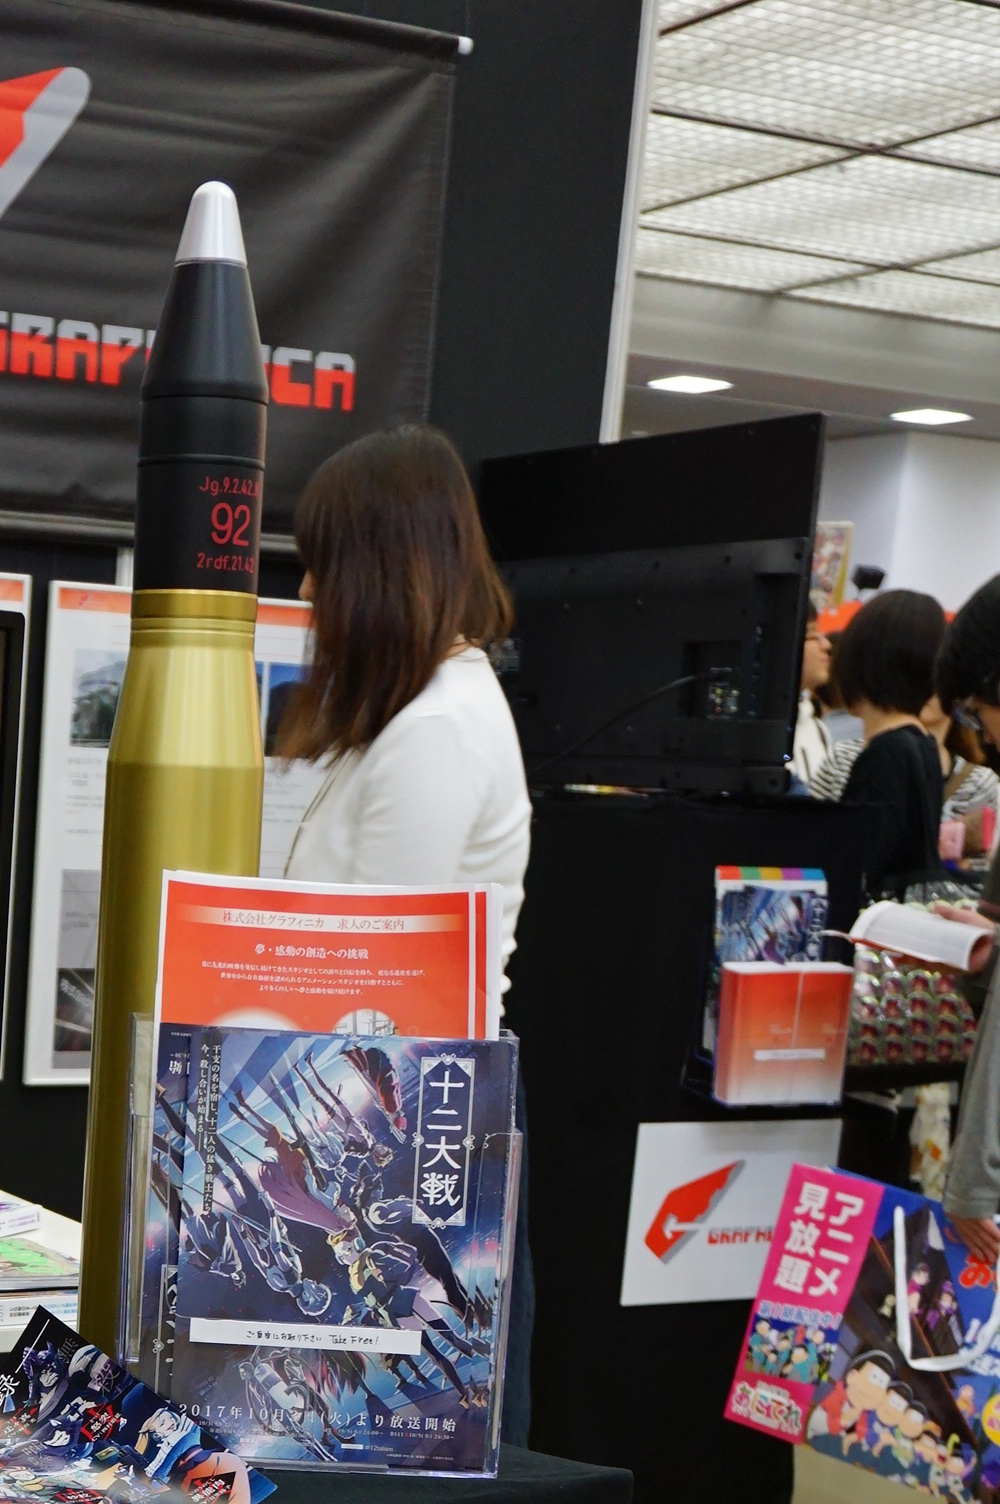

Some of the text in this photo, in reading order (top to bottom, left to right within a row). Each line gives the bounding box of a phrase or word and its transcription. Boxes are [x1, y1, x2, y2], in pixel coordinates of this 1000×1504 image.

[211, 502, 251, 547] 92
[222, 911, 405, 931] 株式会社グラフィニカ 求人のご案内
[254, 943, 370, 960] 夢・感動の創造への挑戦
[420, 1070, 465, 1206] 十二大戦
[773, 1180, 830, 1295] 見放題
[808, 1191, 865, 1296] アニメ
[328, 1334, 347, 1345] Take
[350, 1335, 379, 1346] Free!
